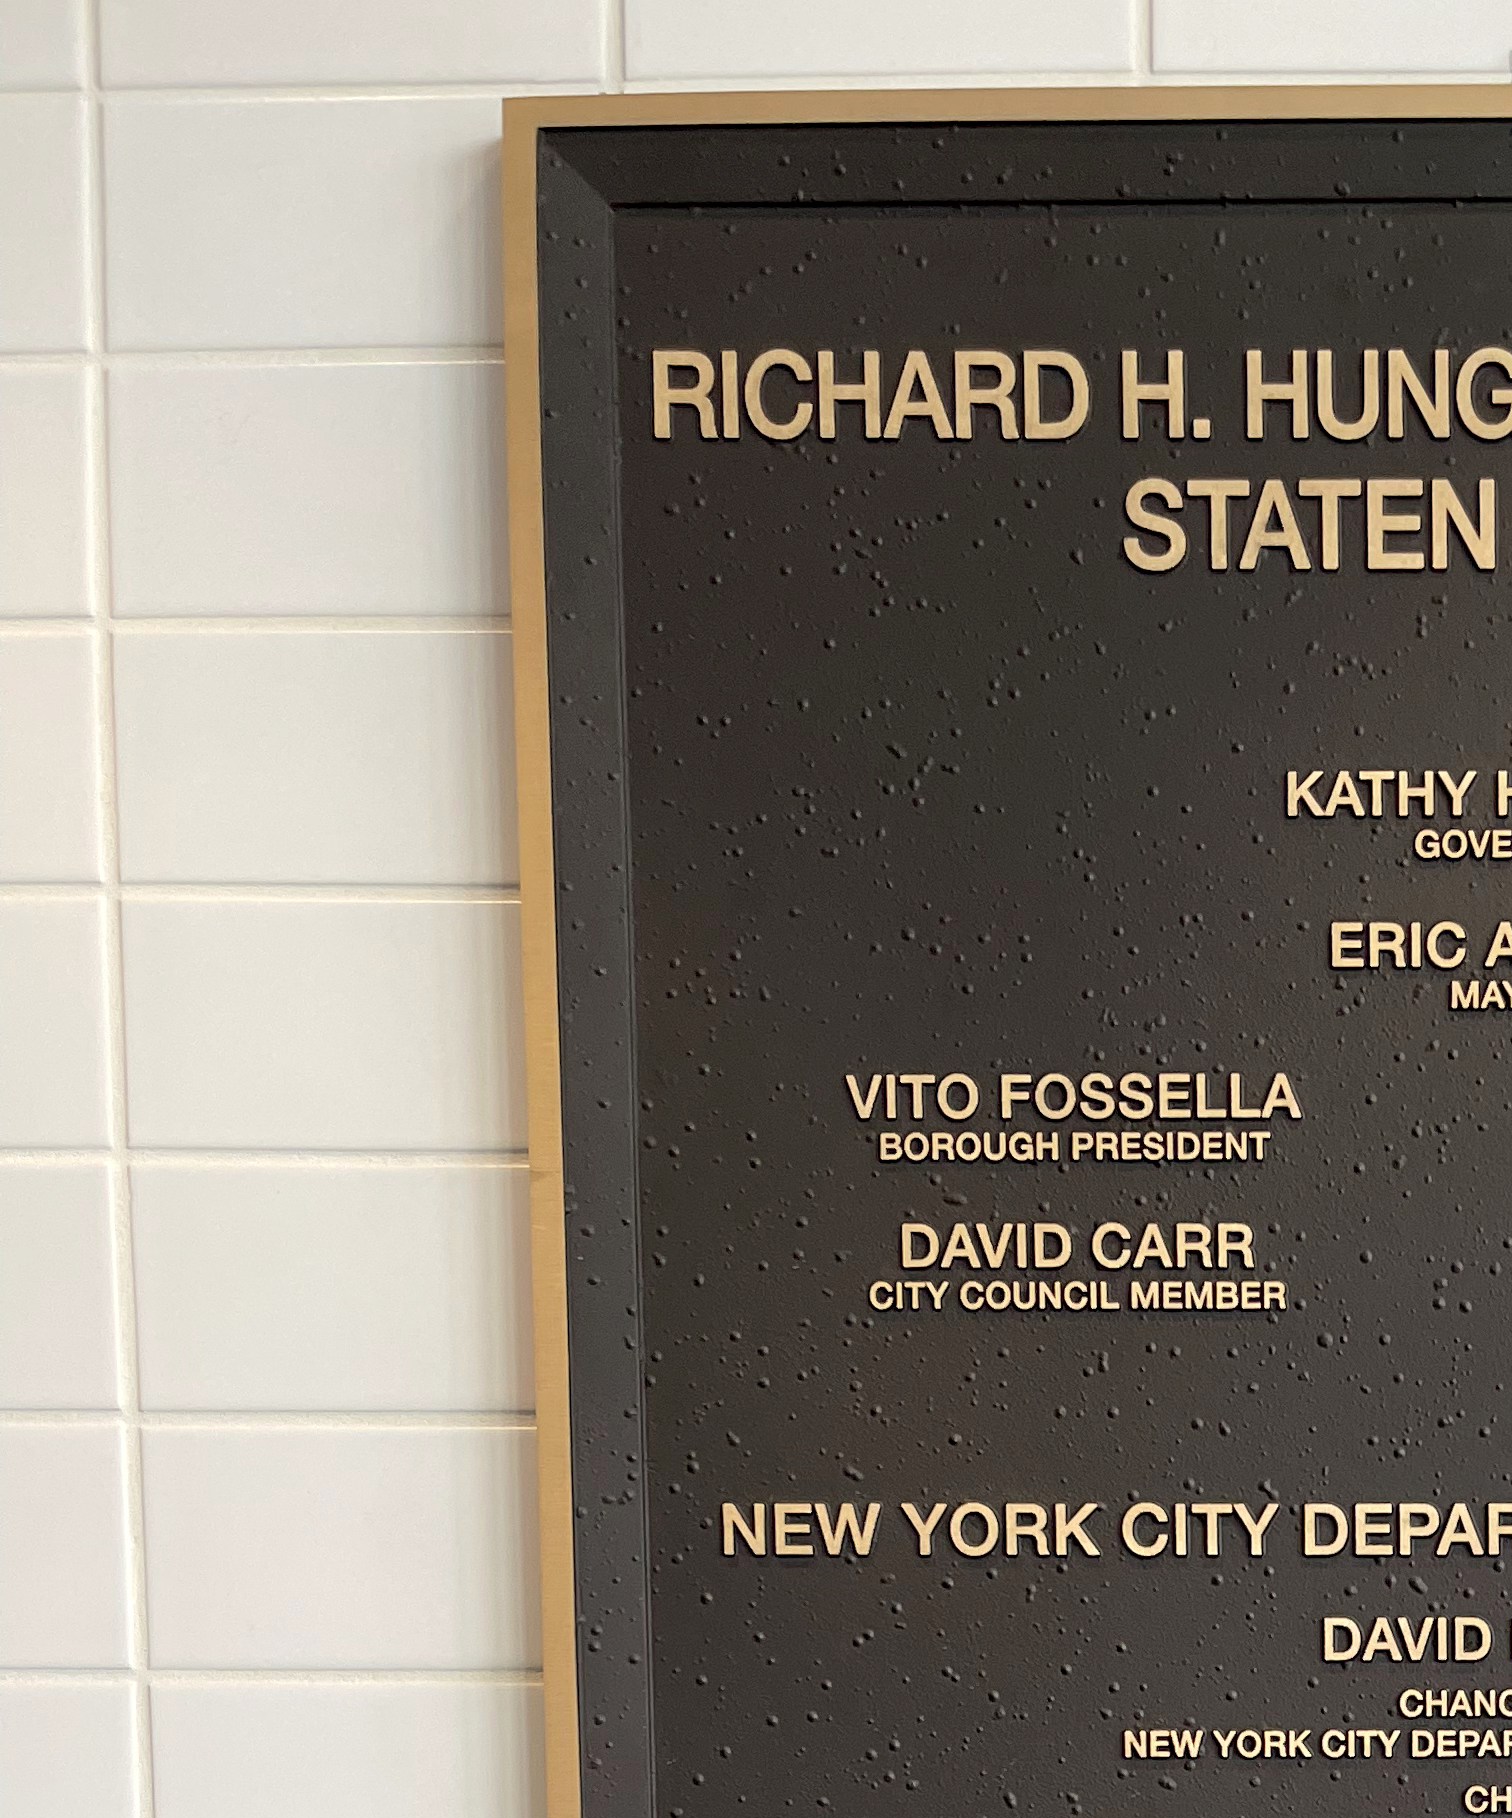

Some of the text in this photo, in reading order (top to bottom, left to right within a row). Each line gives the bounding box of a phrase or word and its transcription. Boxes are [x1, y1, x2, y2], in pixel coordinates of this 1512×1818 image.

[652, 348, 1090, 440] RICHARD
[1121, 349, 1211, 439] H.
[1123, 477, 1496, 572] STATEN
[1287, 770, 1478, 817] KATHY
[1331, 920, 1467, 968] ERIC
[845, 1072, 1302, 1120] VITO FOSSELLA
[879, 1131, 1272, 1161] BOROUGH PRESIDENT
[901, 1221, 1255, 1269] DAVID CARR
[869, 1280, 1287, 1310] CITY COUNCIL MEMBER
[722, 1502, 881, 1556] NEW
[900, 1501, 1101, 1557] YORK
[1121, 1502, 1280, 1557] CITY
[1323, 1616, 1492, 1662] DAVID
[1124, 1729, 1204, 1758] NEW
[1212, 1729, 1313, 1759] YORK
[1321, 1729, 1401, 1758] CITY
